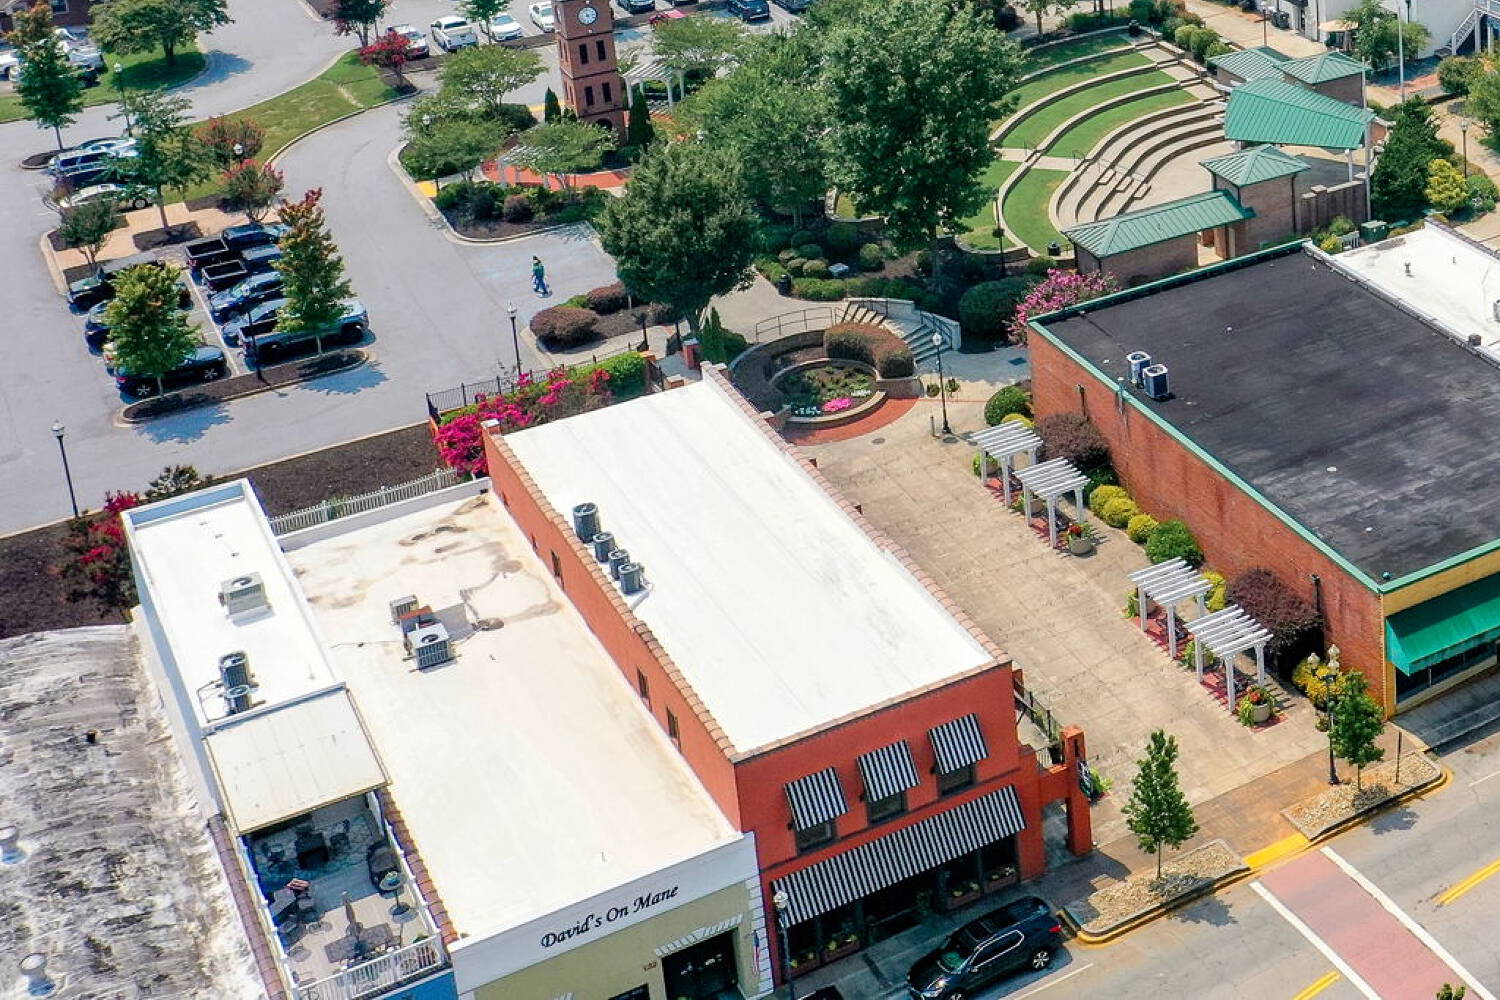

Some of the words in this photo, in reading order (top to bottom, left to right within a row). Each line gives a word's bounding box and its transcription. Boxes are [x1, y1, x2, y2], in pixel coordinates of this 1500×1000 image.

[540, 914, 602, 948] David's
[606, 905, 629, 923] On
[633, 886, 679, 913] Mane
